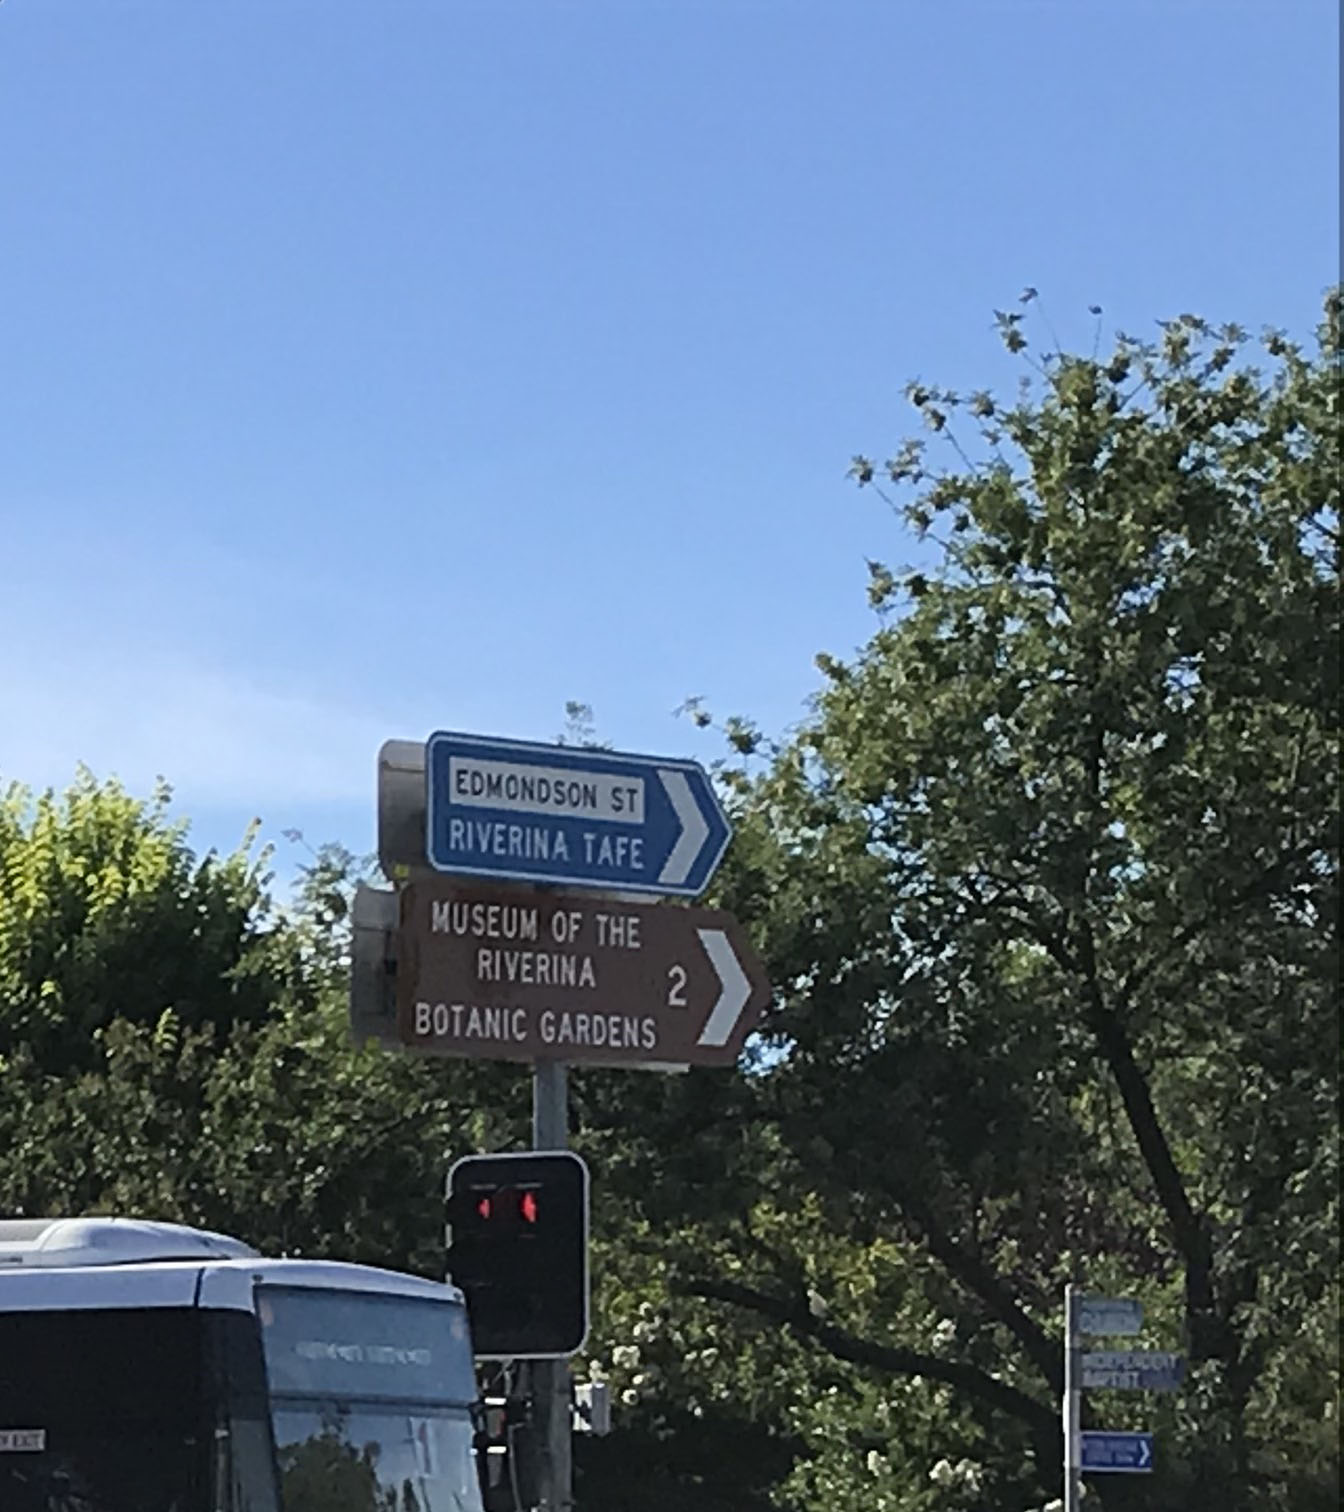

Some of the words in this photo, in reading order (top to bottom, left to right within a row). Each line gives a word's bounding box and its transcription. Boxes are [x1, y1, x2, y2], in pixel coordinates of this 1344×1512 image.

[455, 768, 598, 809] EDMONDSON
[611, 786, 639, 813] ST
[449, 818, 570, 862] RIVERINA
[583, 832, 645, 870] TAFE
[431, 900, 538, 942] MUSEUM
[551, 910, 583, 944] OF
[595, 913, 642, 949] THE
[477, 948, 597, 988] RIVERINA
[666, 964, 688, 1007] 2
[415, 1002, 528, 1042] BOTANIC
[540, 1010, 657, 1050] GARDENS
[12, 1432, 41, 1448] EXIT
